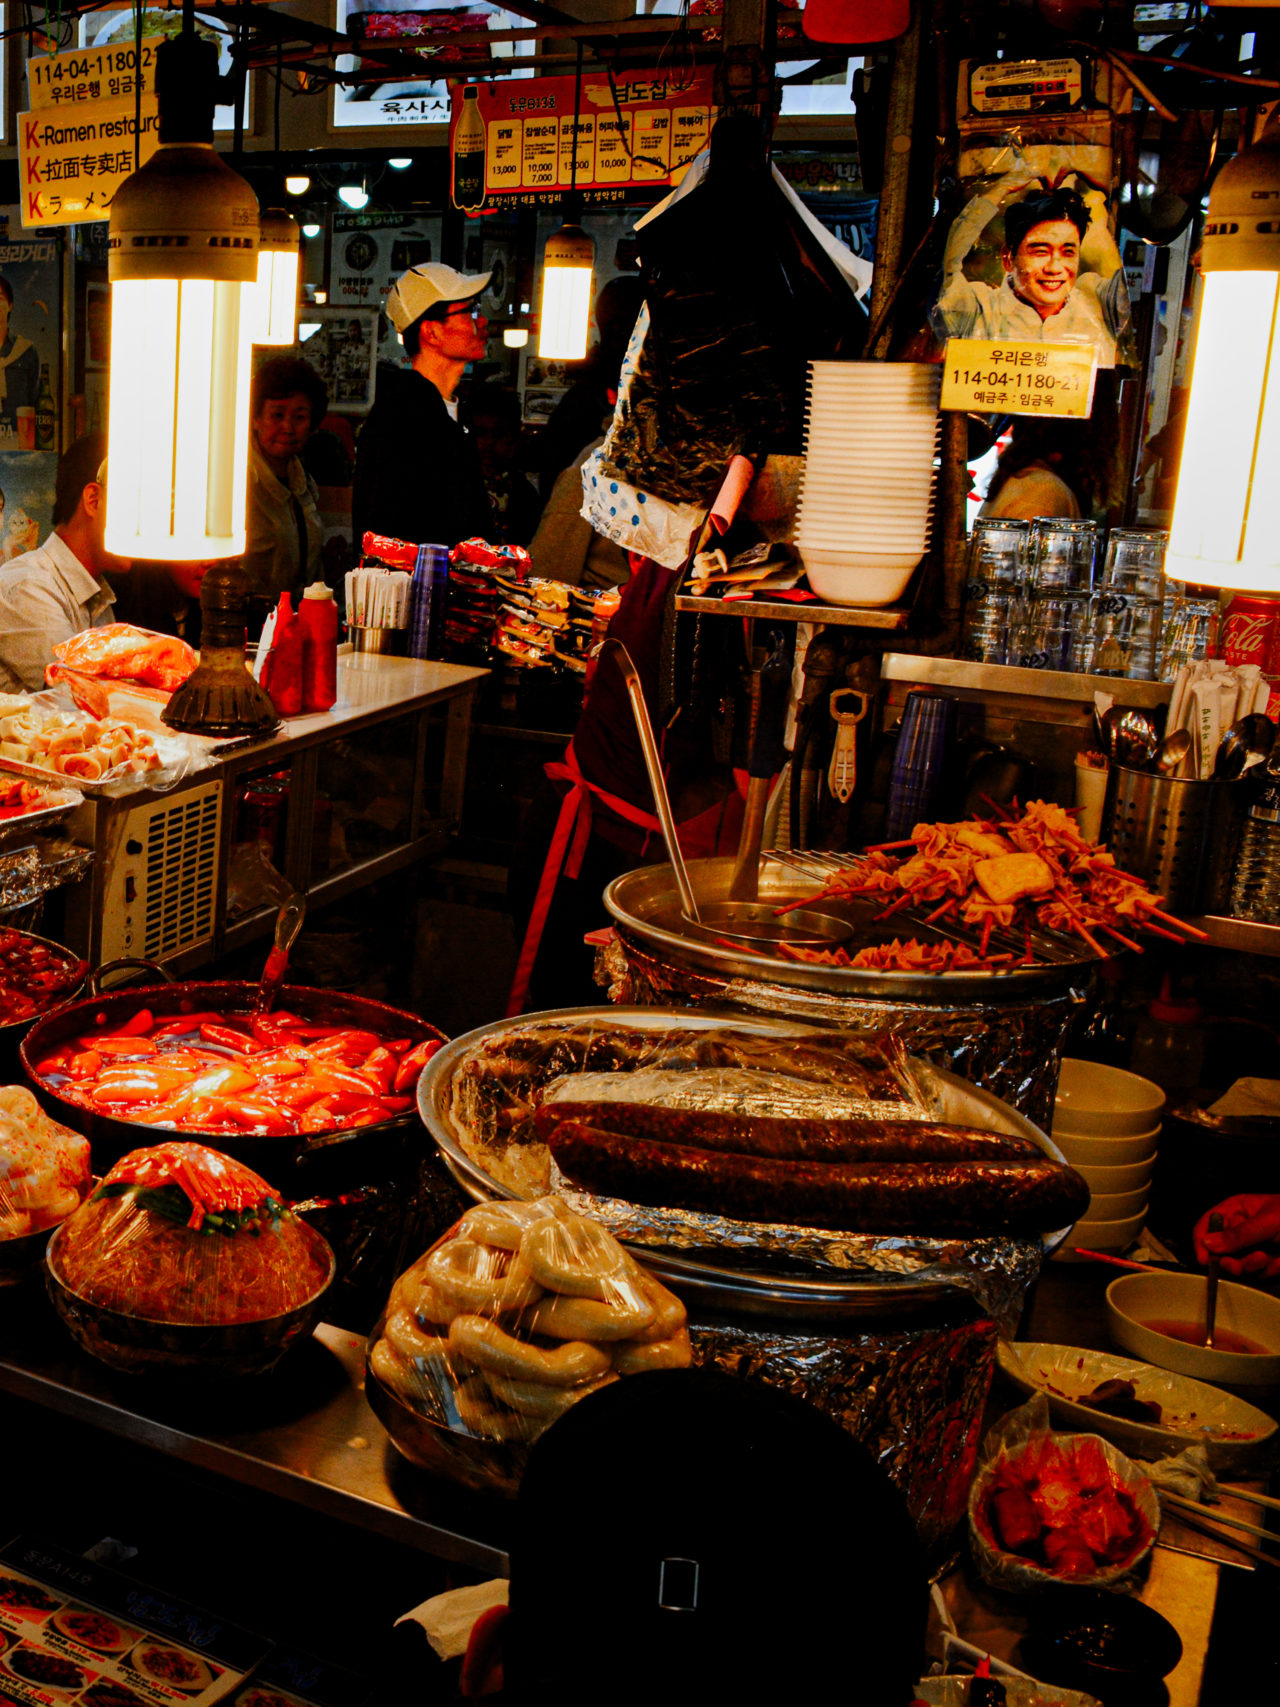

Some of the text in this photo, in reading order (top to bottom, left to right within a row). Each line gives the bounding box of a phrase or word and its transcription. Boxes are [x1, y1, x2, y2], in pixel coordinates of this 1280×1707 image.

[51, 79, 101, 104] 우리은행
[653, 118, 669, 129] 김밥
[26, 120, 96, 149] K-Ramen
[28, 150, 133, 184] K-拉面专卖店
[493, 165, 517, 175] 13,000
[528, 162, 553, 173] 10,000
[601, 159, 626, 169] 10,000
[532, 173, 553, 183] 7,000
[521, 193, 536, 205] 대표
[990, 349, 1049, 367] 우리은행
[953, 370, 1080, 390] 114-04-1180-21
[974, 391, 1008, 404] 예금주
[1020, 393, 1055, 407] 임금옥
